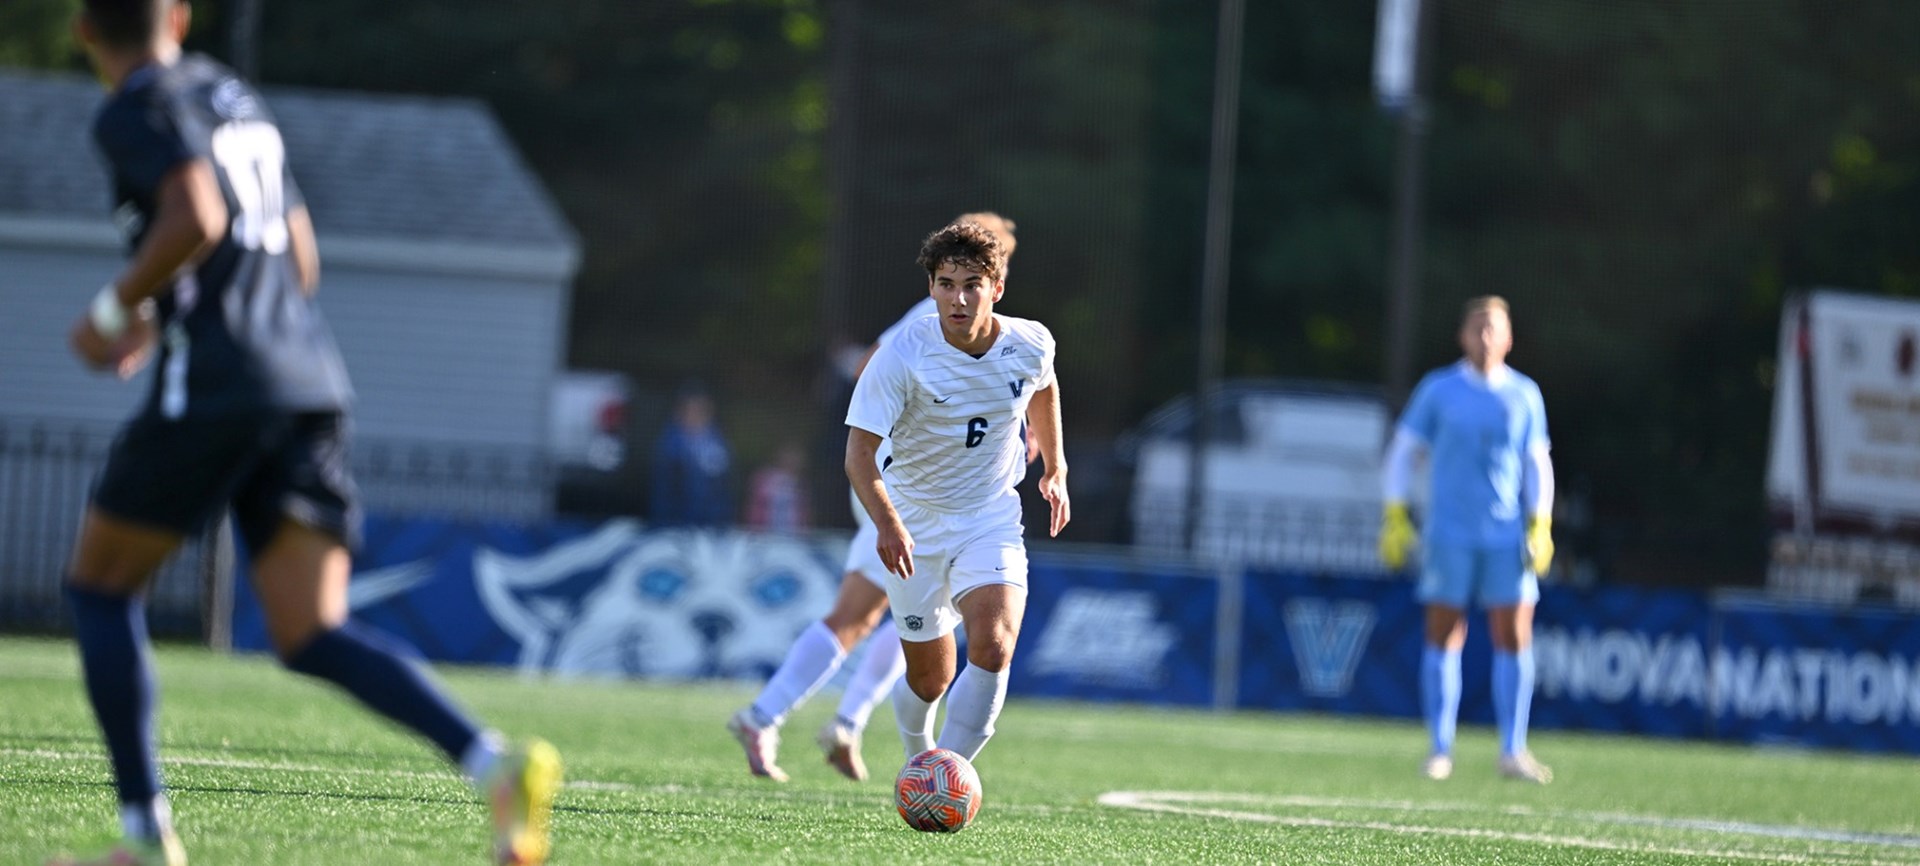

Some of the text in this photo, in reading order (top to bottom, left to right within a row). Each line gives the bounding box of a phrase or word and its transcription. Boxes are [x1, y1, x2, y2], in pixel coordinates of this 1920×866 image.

[1009, 378, 1026, 398] V
[965, 417, 988, 449] 6
[1283, 598, 1377, 696] V
